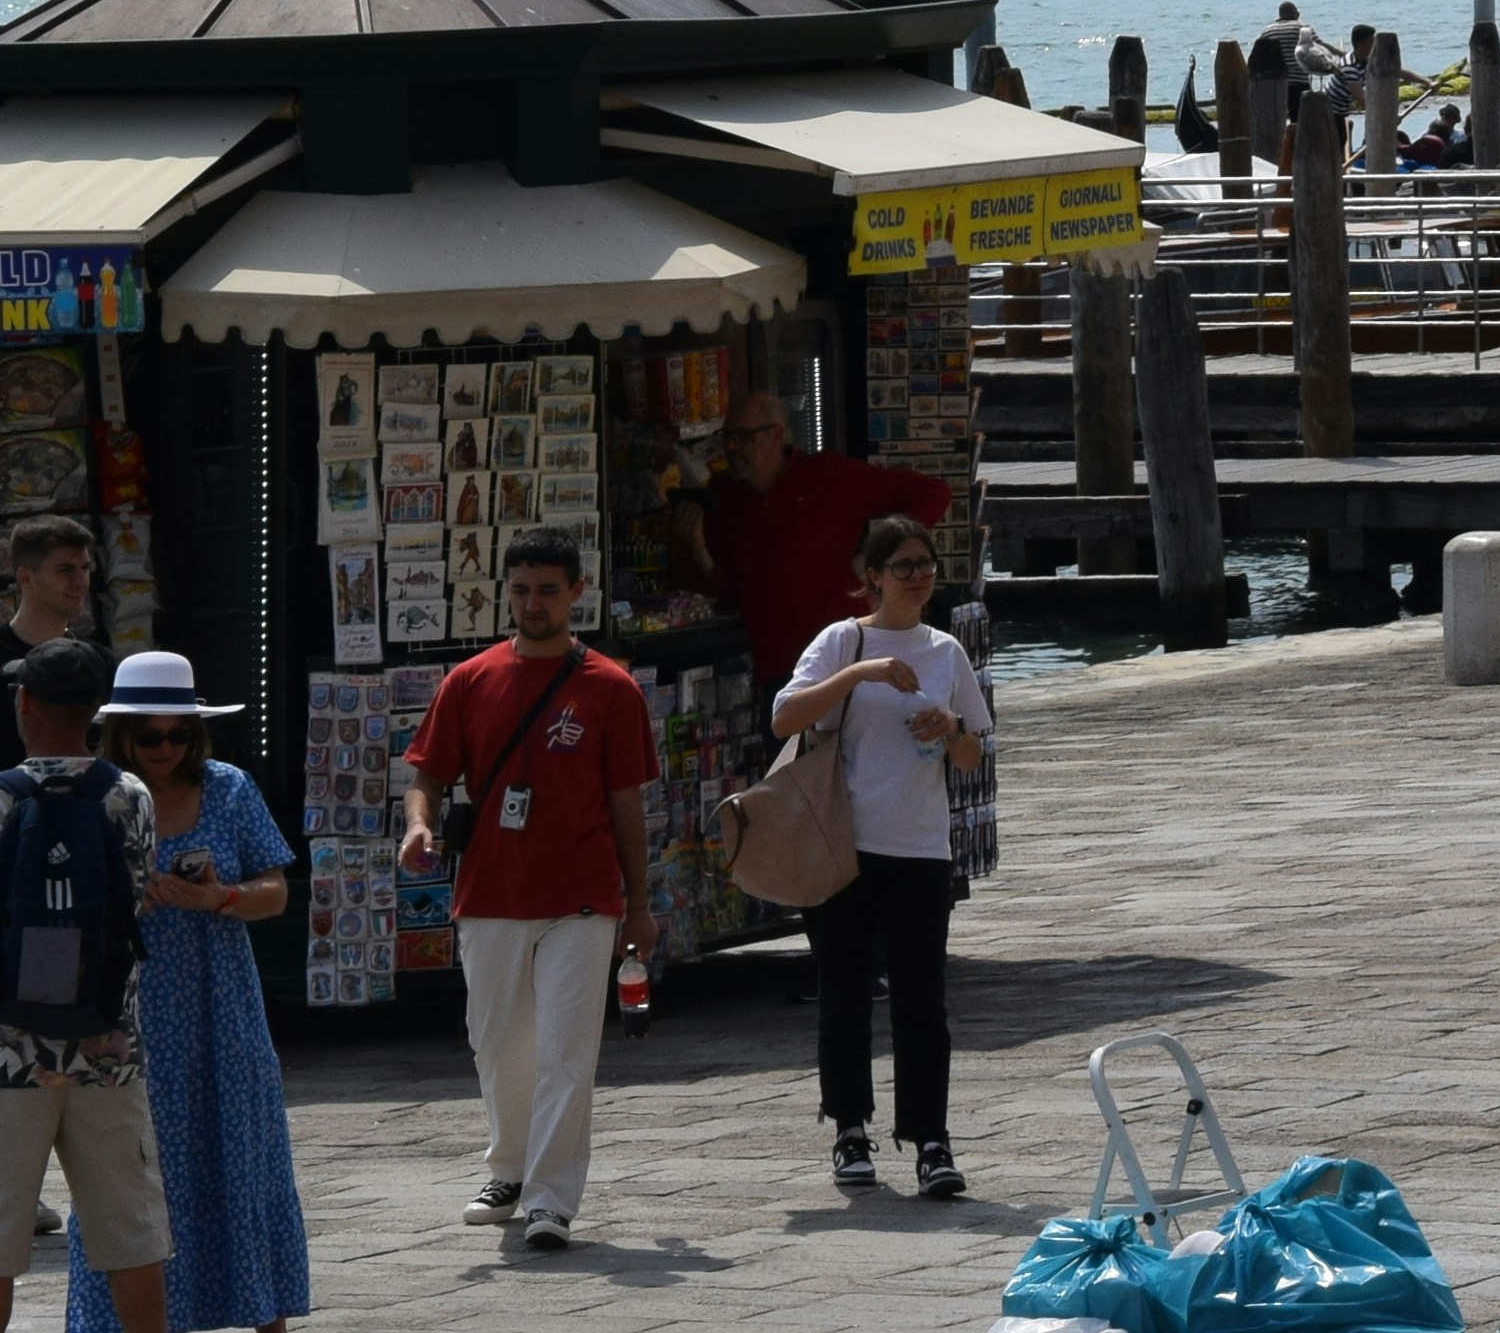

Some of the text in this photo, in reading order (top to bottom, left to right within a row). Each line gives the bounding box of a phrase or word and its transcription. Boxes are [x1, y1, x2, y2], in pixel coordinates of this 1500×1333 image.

[970, 194, 1035, 219] BEVANDE
[1059, 183, 1123, 208] GIORNALI
[867, 207, 906, 229] COLD
[1050, 213, 1135, 242] NEWSPAPER
[862, 237, 917, 262] DRINKS
[969, 226, 1032, 251] FRESCHE
[0, 249, 51, 287] LD
